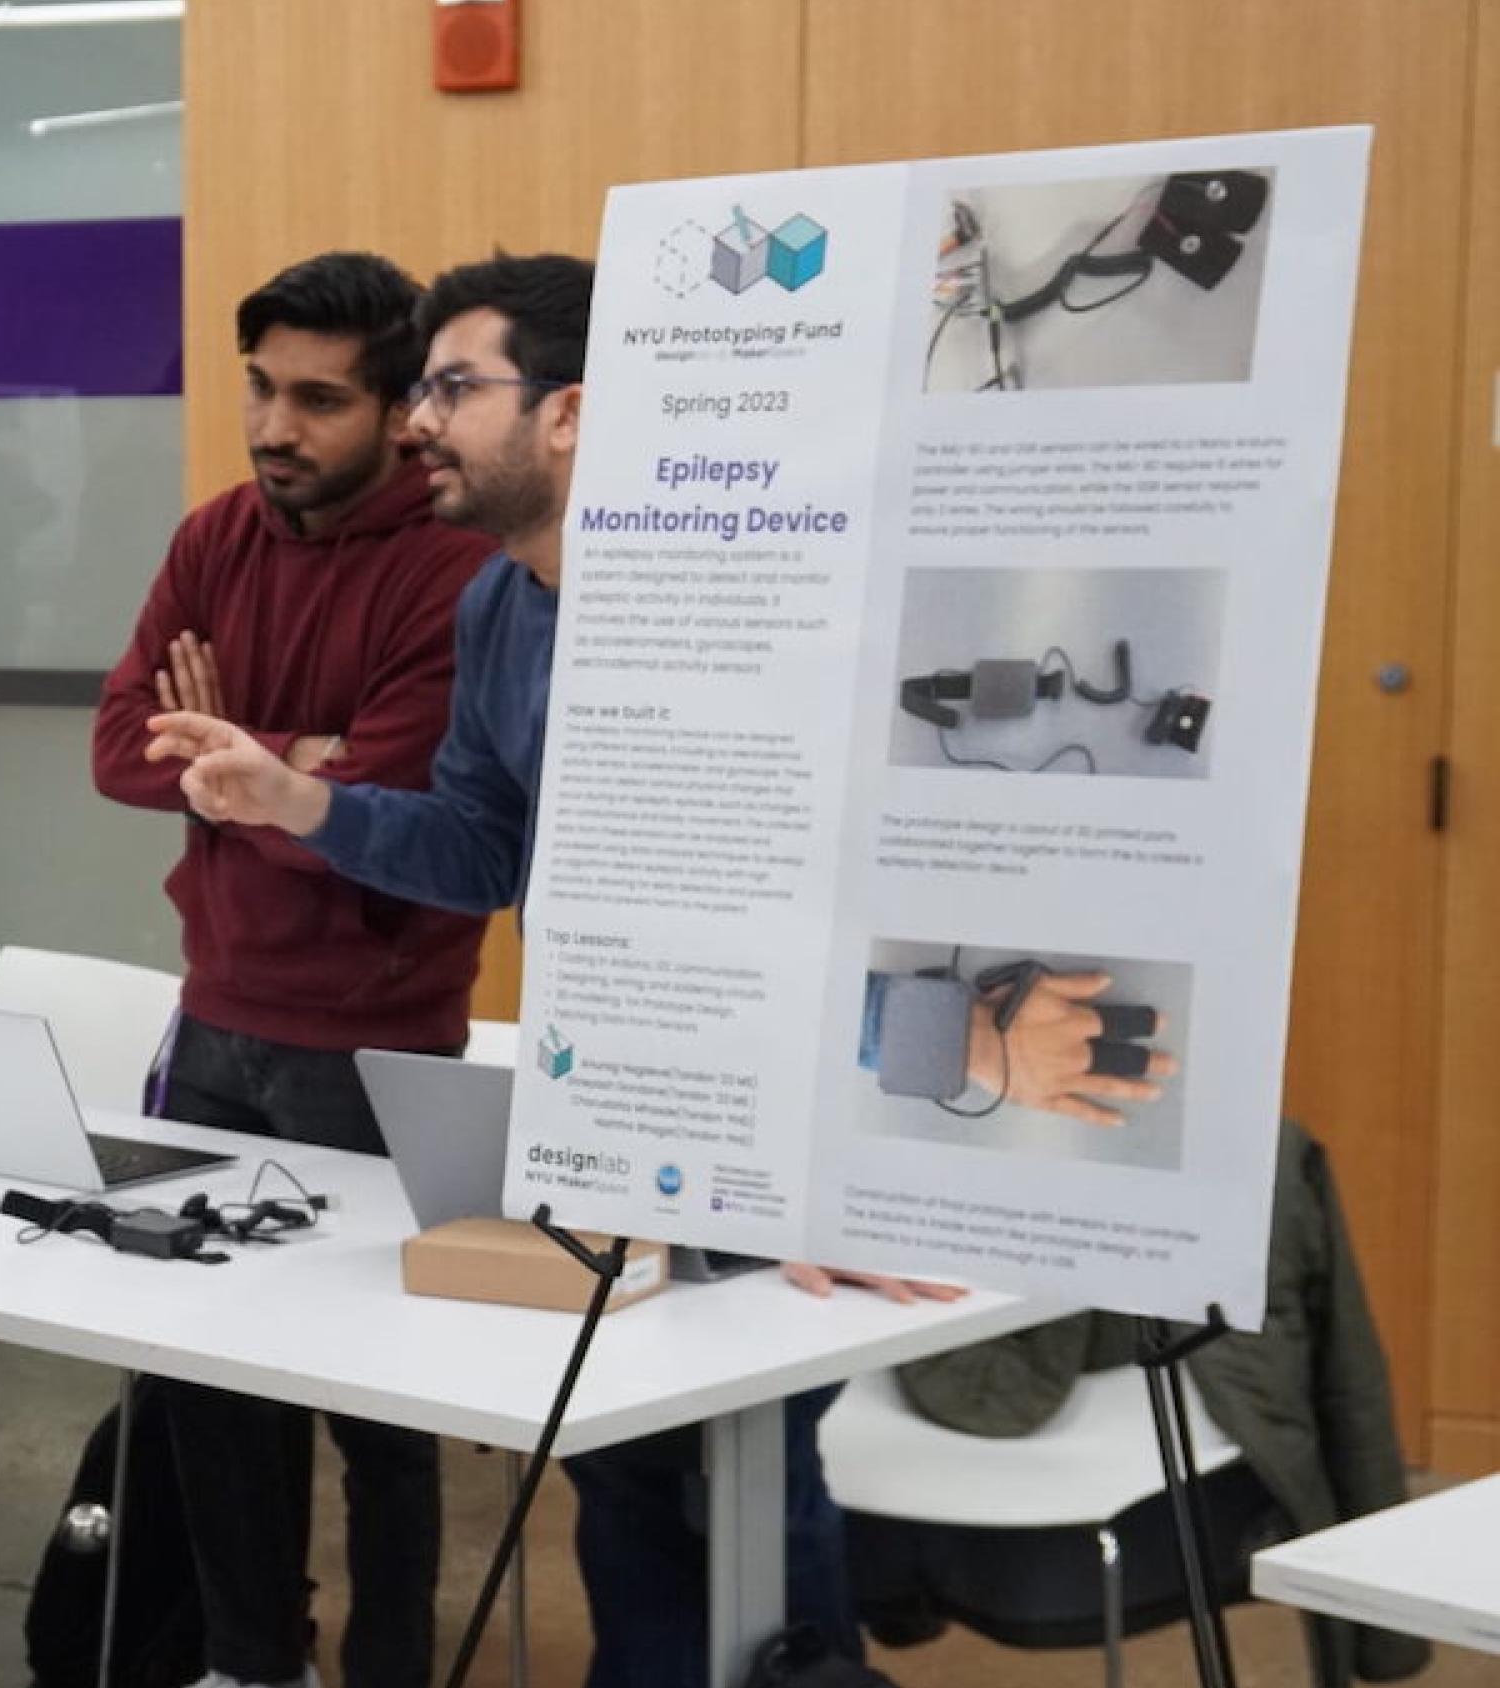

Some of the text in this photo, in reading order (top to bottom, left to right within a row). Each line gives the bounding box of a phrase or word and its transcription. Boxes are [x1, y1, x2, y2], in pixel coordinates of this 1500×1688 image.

[623, 321, 843, 347] NYU Prototyping Fund
[662, 391, 789, 419] Spring 2023
[656, 454, 779, 491] Epilepsy
[581, 505, 848, 541] Monitoring Device
[527, 1144, 631, 1175] designlab
